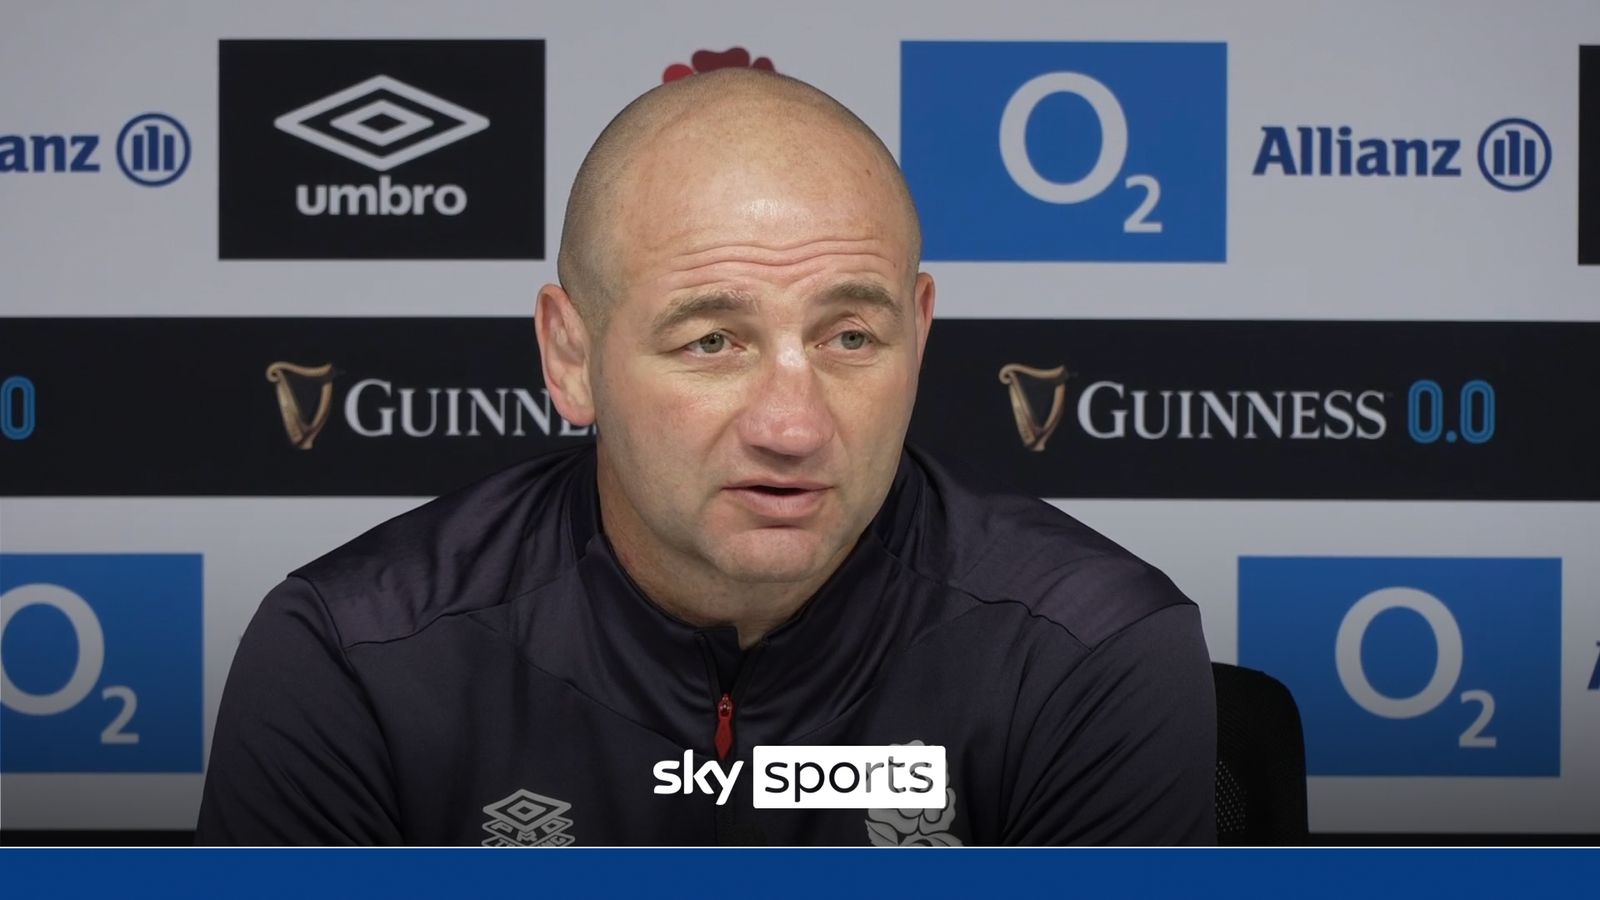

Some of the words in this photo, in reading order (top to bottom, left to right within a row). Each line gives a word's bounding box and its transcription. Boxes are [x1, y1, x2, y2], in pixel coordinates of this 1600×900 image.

[999, 71, 1163, 233] O2
[1252, 126, 1462, 177] Allianz
[296, 176, 468, 217] umbro
[344, 378, 597, 437] GUINN
[1077, 381, 1387, 440] GUINNESS
[1407, 379, 1496, 443] 0.0
[0, 583, 140, 744] O2
[1335, 586, 1497, 748] O2
